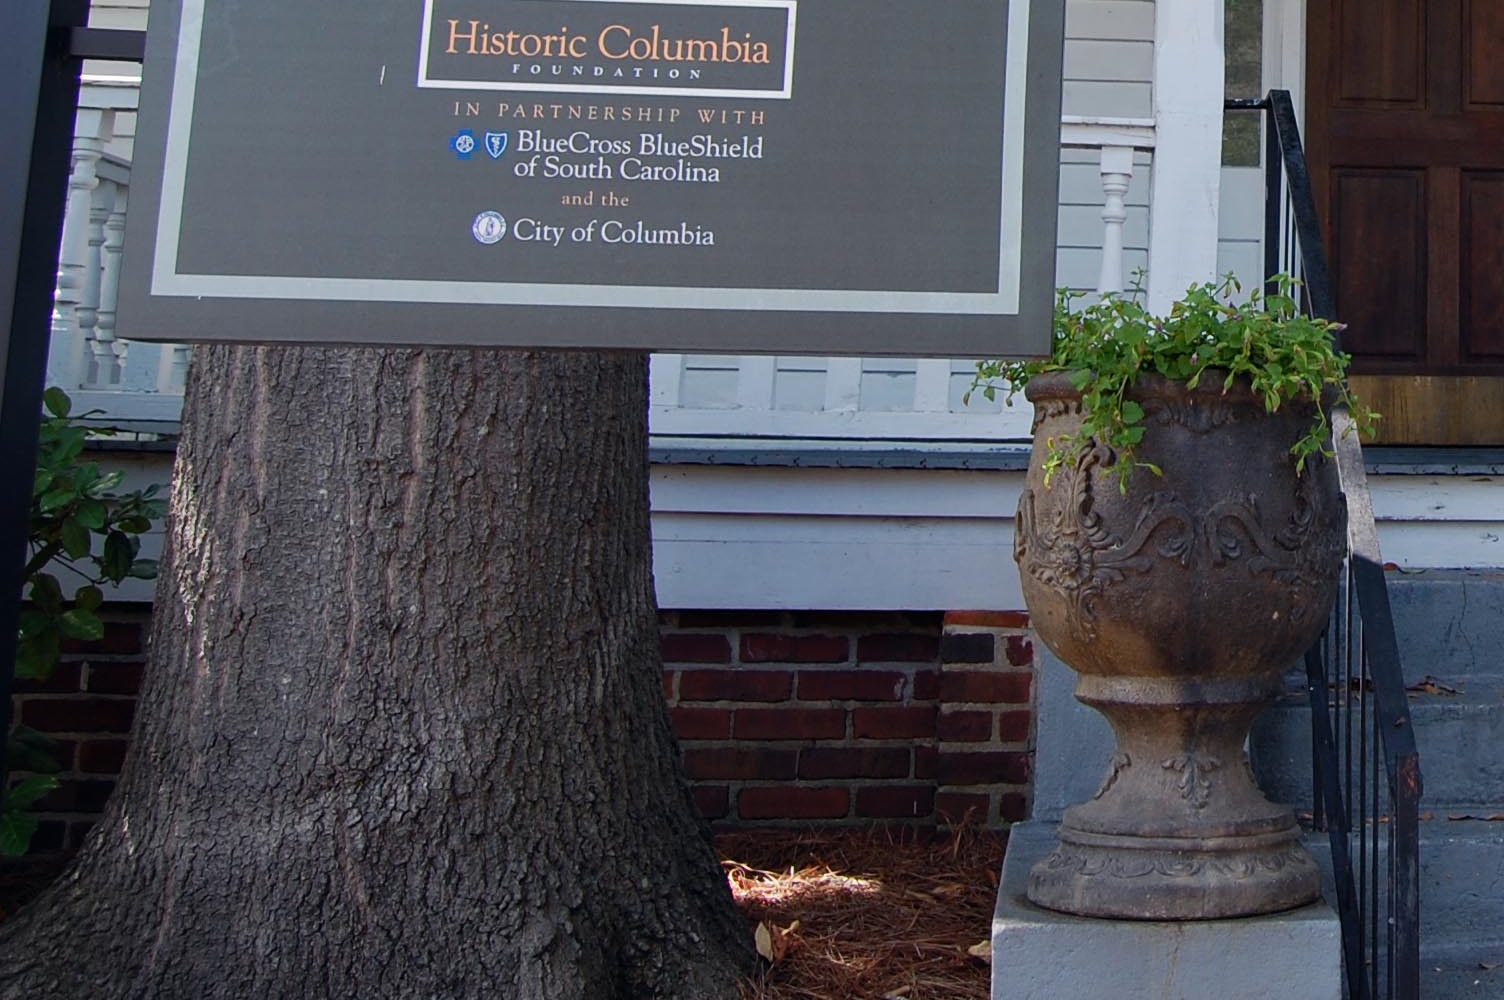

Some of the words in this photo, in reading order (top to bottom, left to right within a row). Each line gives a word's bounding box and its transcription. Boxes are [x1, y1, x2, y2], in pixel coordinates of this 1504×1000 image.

[445, 20, 587, 58] Historic
[598, 25, 770, 64] Columbia
[512, 63, 703, 80] FOUNDATION
[453, 101, 481, 117] IN
[498, 103, 680, 123] PARTNERSHIP
[698, 109, 766, 126] WITH
[516, 130, 632, 155] BlueCross
[639, 134, 764, 160] BlueShield
[513, 155, 540, 179] of
[543, 157, 612, 180] South
[619, 160, 721, 184] Carolina
[561, 191, 593, 207] and
[600, 192, 630, 208] the
[513, 218, 564, 248] City
[570, 220, 597, 242] of
[600, 221, 716, 247] Columbia
